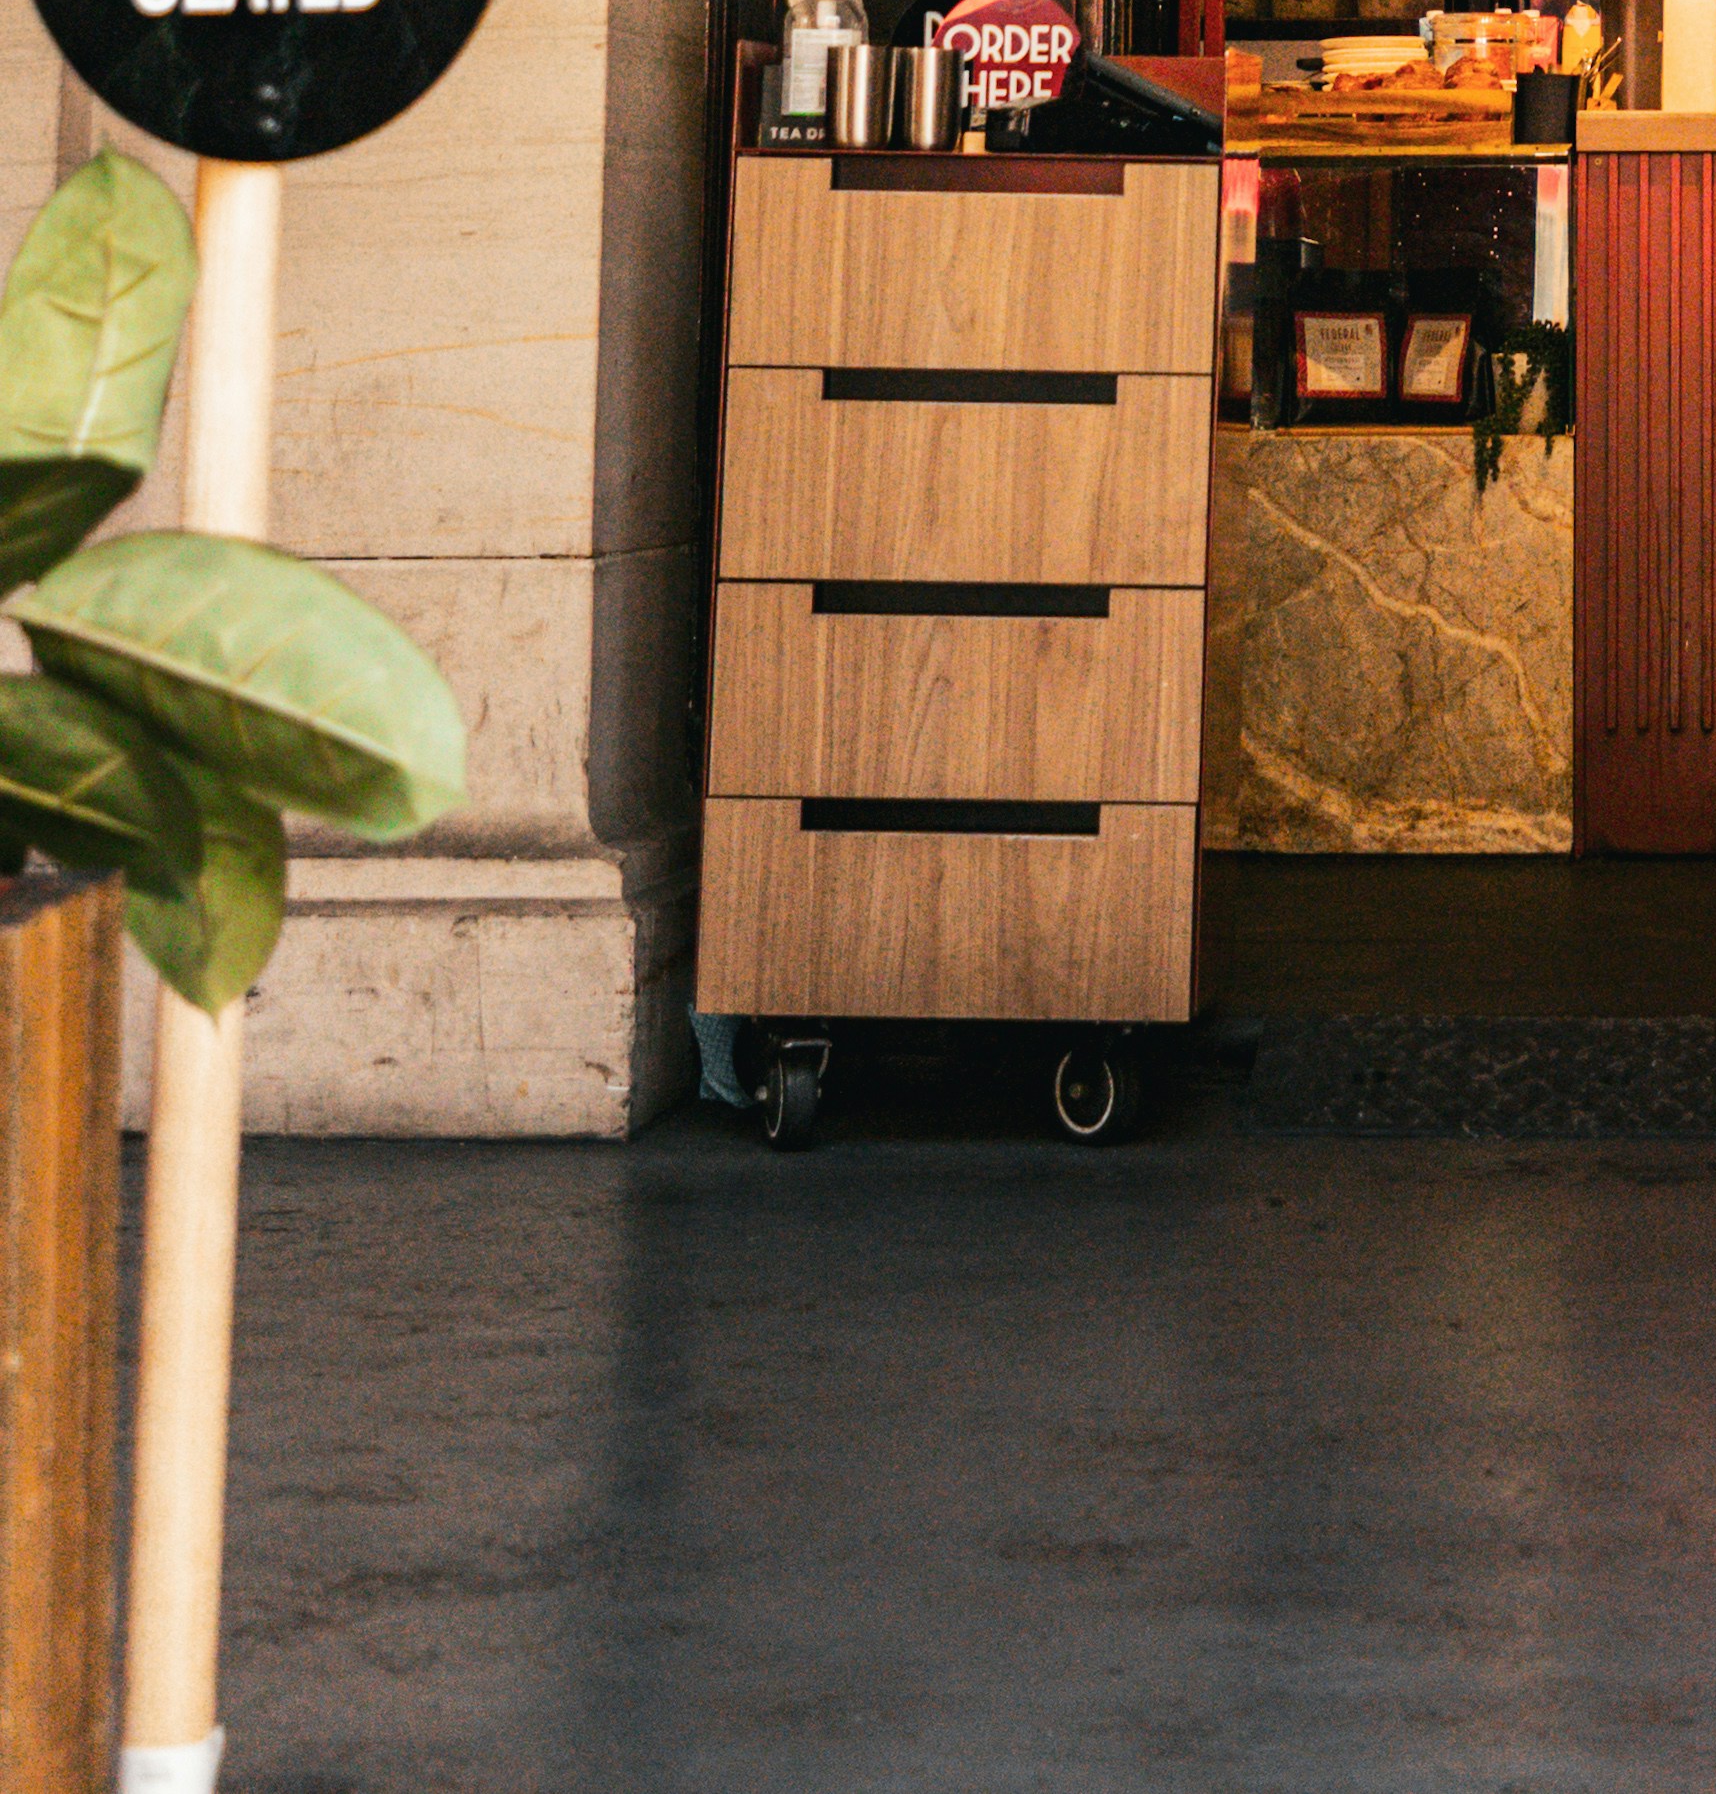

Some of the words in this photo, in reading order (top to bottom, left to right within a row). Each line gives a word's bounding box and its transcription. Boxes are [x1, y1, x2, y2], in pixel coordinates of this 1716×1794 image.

[943, 22, 1074, 64] ORDER
[962, 69, 1053, 109] HERE
[769, 126, 802, 141] TEA
